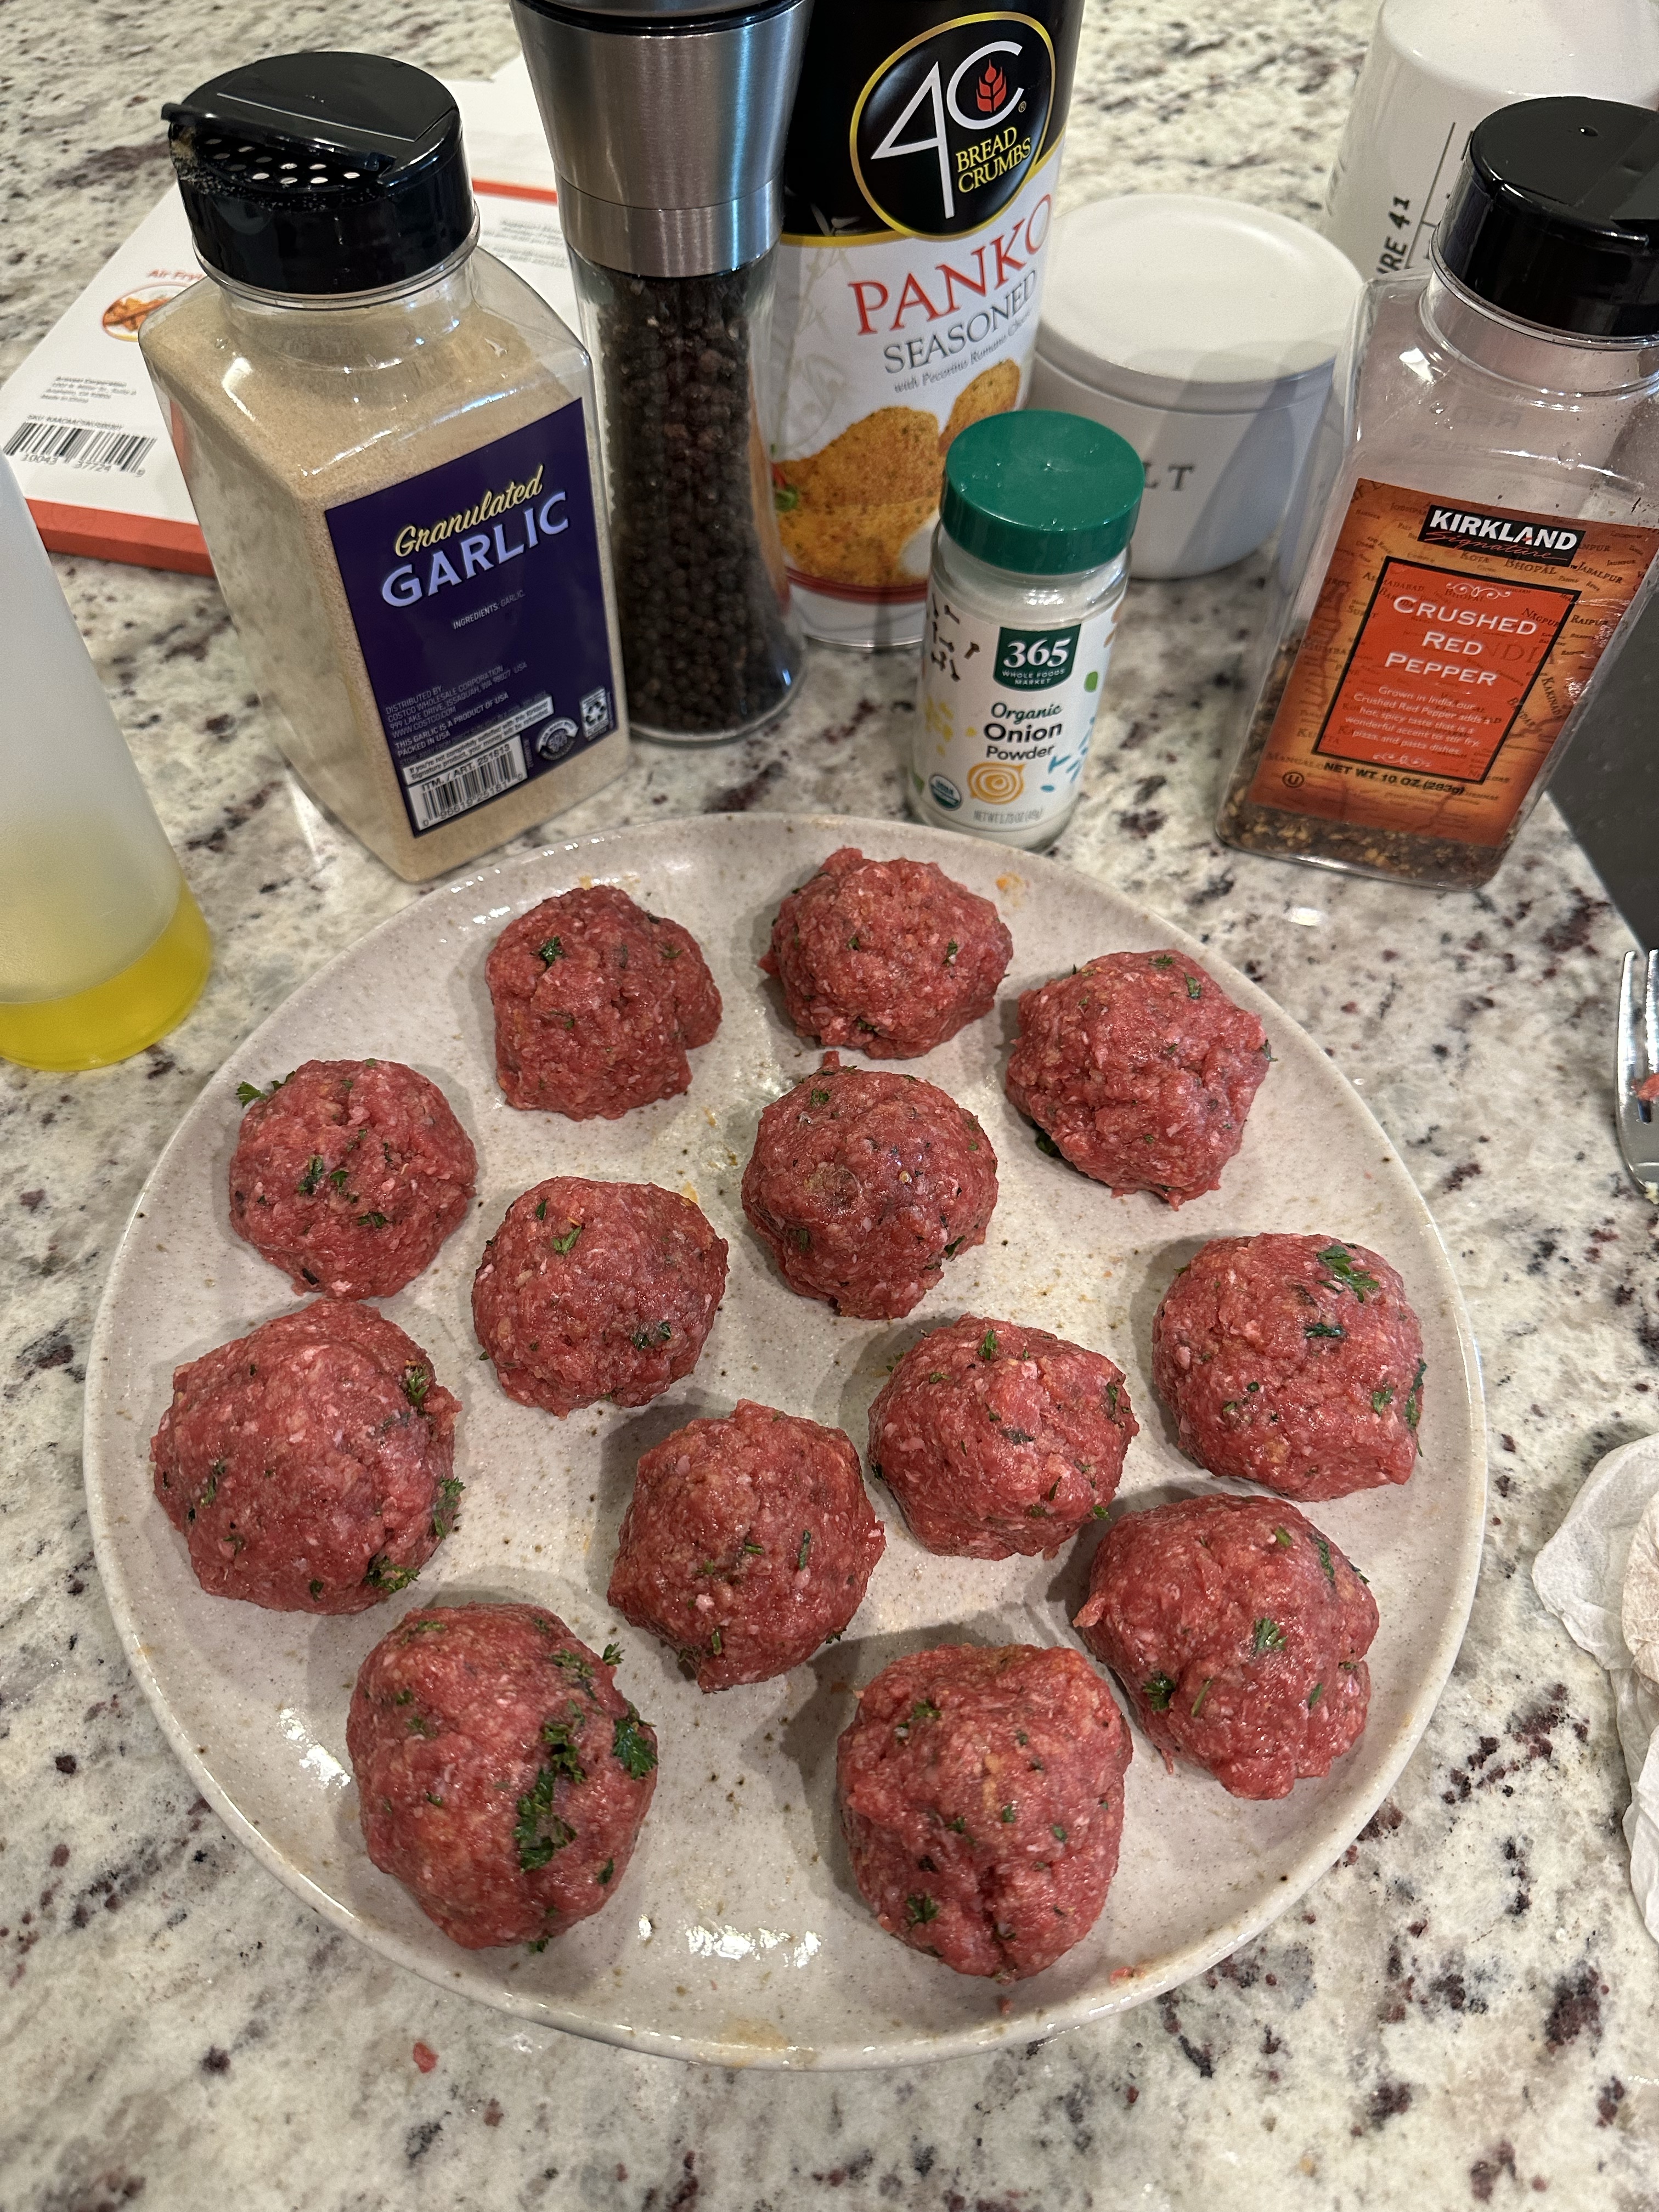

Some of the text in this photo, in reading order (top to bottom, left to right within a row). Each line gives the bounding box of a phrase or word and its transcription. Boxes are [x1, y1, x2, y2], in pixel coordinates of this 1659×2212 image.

[871, 41, 1024, 219] 4C
[955, 127, 1018, 173] BREAD
[958, 137, 1032, 194] CRUMBS
[1389, 196, 1410, 229] 41
[848, 194, 1051, 336] PANKO
[884, 270, 1036, 374] SEASONED
[1144, 462, 1194, 492] LT
[394, 464, 544, 558] Granulated
[1429, 510, 1578, 550] KIRKLAND
[382, 490, 569, 607] GARLIC
[1423, 530, 1568, 561] Signature
[1460, 550, 1489, 564] KOTA
[1579, 544, 1611, 552] NPUR
[1504, 557, 1557, 575] BHOPAL
[453, 603, 500, 629] INGREDIENTS:
[1393, 596, 1538, 636] CRUSHED
[1003, 637, 1071, 668] 365
[1421, 631, 1483, 656] RED
[1002, 669, 1065, 679] WHOLE FOODS
[1384, 651, 1498, 686] PEPPER
[386, 690, 432, 714] DISTRIBUTED
[388, 664, 503, 723] COSTCO WHOLESALE CORPORATION
[1353, 692, 1396, 709] Crushed
[1398, 702, 1419, 713] Red
[1420, 706, 1457, 720] Pepper
[1458, 713, 1482, 724] adds
[1378, 685, 1414, 700] Grown
[1416, 694, 1426, 702] in
[390, 720, 403, 730] 999
[404, 713, 422, 725] LAKE
[392, 706, 457, 738] WWW.COSTCO.COM
[395, 691, 509, 749] THIS GARLIC IS A PRODUCT OF USA
[991, 702, 1063, 725] Organic
[1345, 715, 1395, 732] wonderful
[1396, 726, 1429, 738] accent
[1380, 712, 1406, 724] spicy
[1408, 717, 1433, 727] taste
[397, 730, 450, 757] PACKED IN USA
[983, 722, 1063, 744] Onion
[1381, 734, 1400, 744] and
[1400, 740, 1427, 751] pasta
[421, 777, 444, 792] ITM.
[454, 763, 476, 776] ART.
[477, 743, 510, 766] 251813
[986, 744, 1056, 761] Powder
[1323, 761, 1353, 775] NET
[1381, 774, 1397, 784] 10
[1401, 777, 1422, 788] OZ
